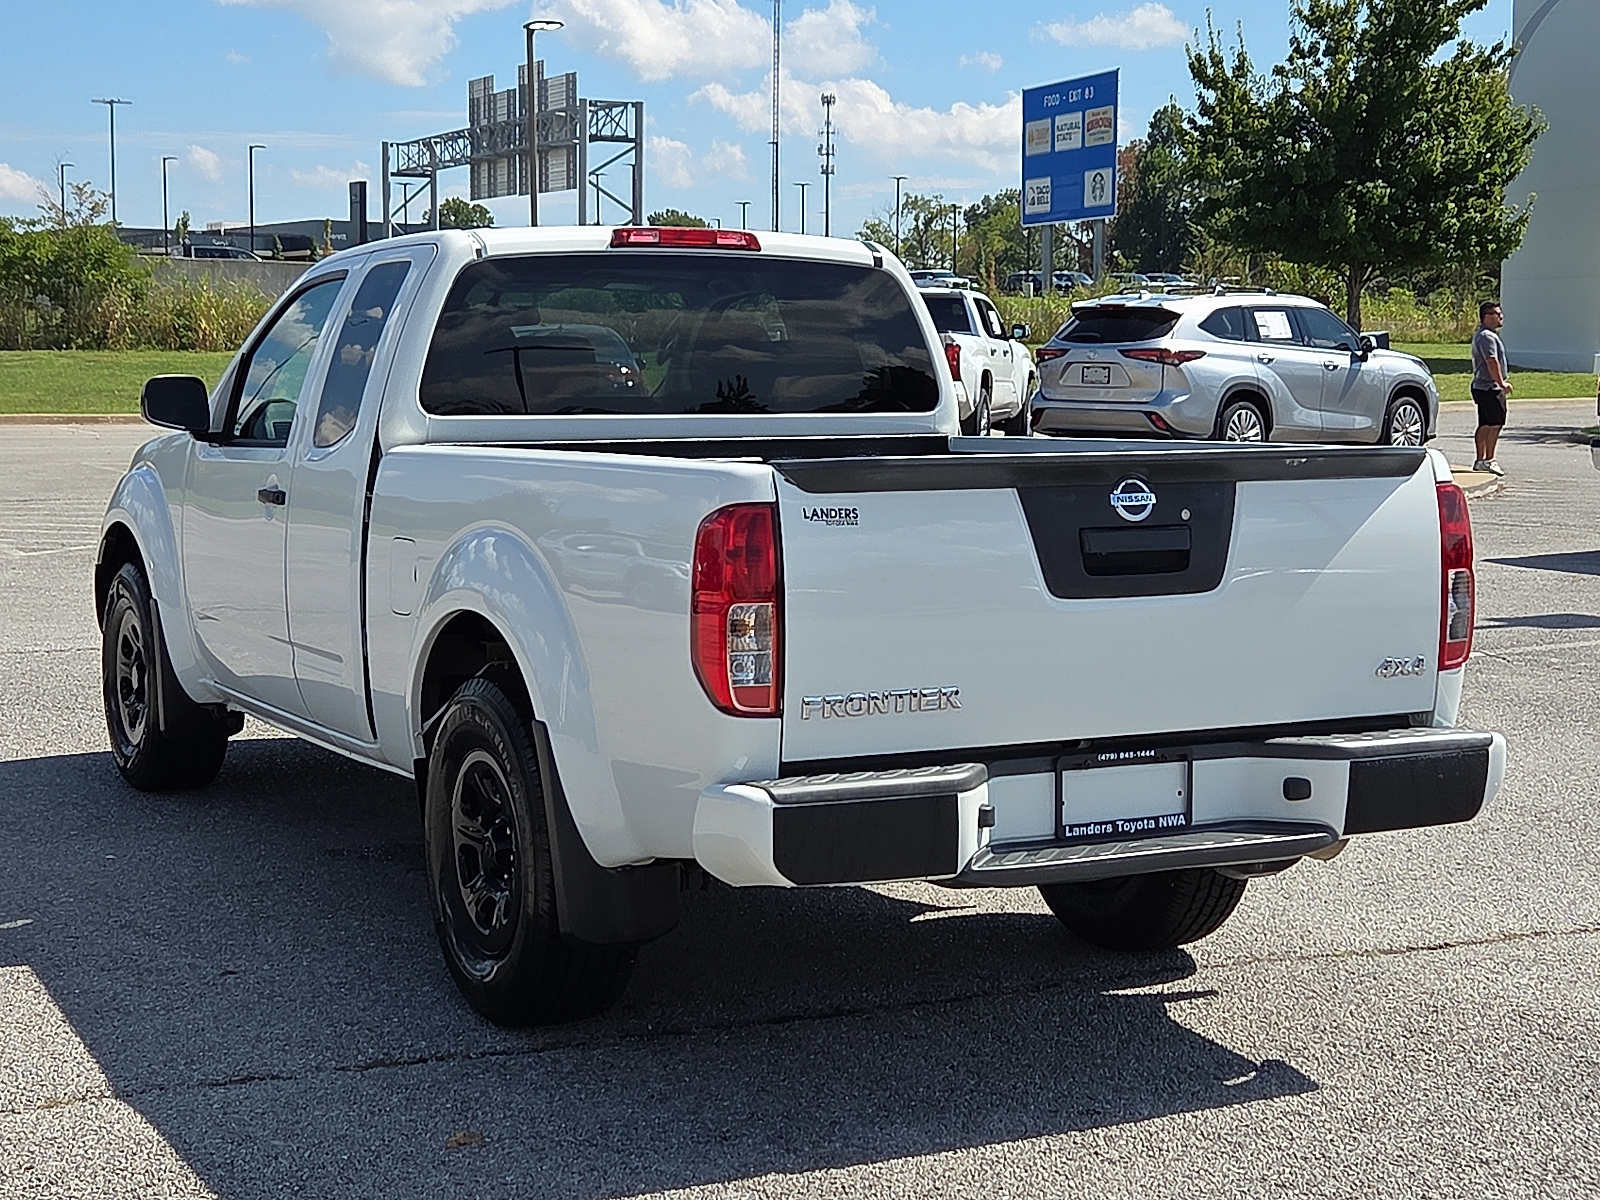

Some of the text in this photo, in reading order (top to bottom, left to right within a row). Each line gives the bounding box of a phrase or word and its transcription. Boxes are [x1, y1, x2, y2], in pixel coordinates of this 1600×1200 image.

[1043, 93, 1060, 107] FOOD
[1069, 88, 1081, 103] EXIT
[1056, 132, 1072, 143] STATE
[1035, 184, 1050, 195] TACO
[1036, 195, 1050, 206] BELL
[1116, 494, 1153, 503] NISSAN
[802, 507, 859, 520] LANDERS
[801, 685, 962, 720] FRONTIER
[1065, 814, 1186, 837] Landers Toyota NWA
